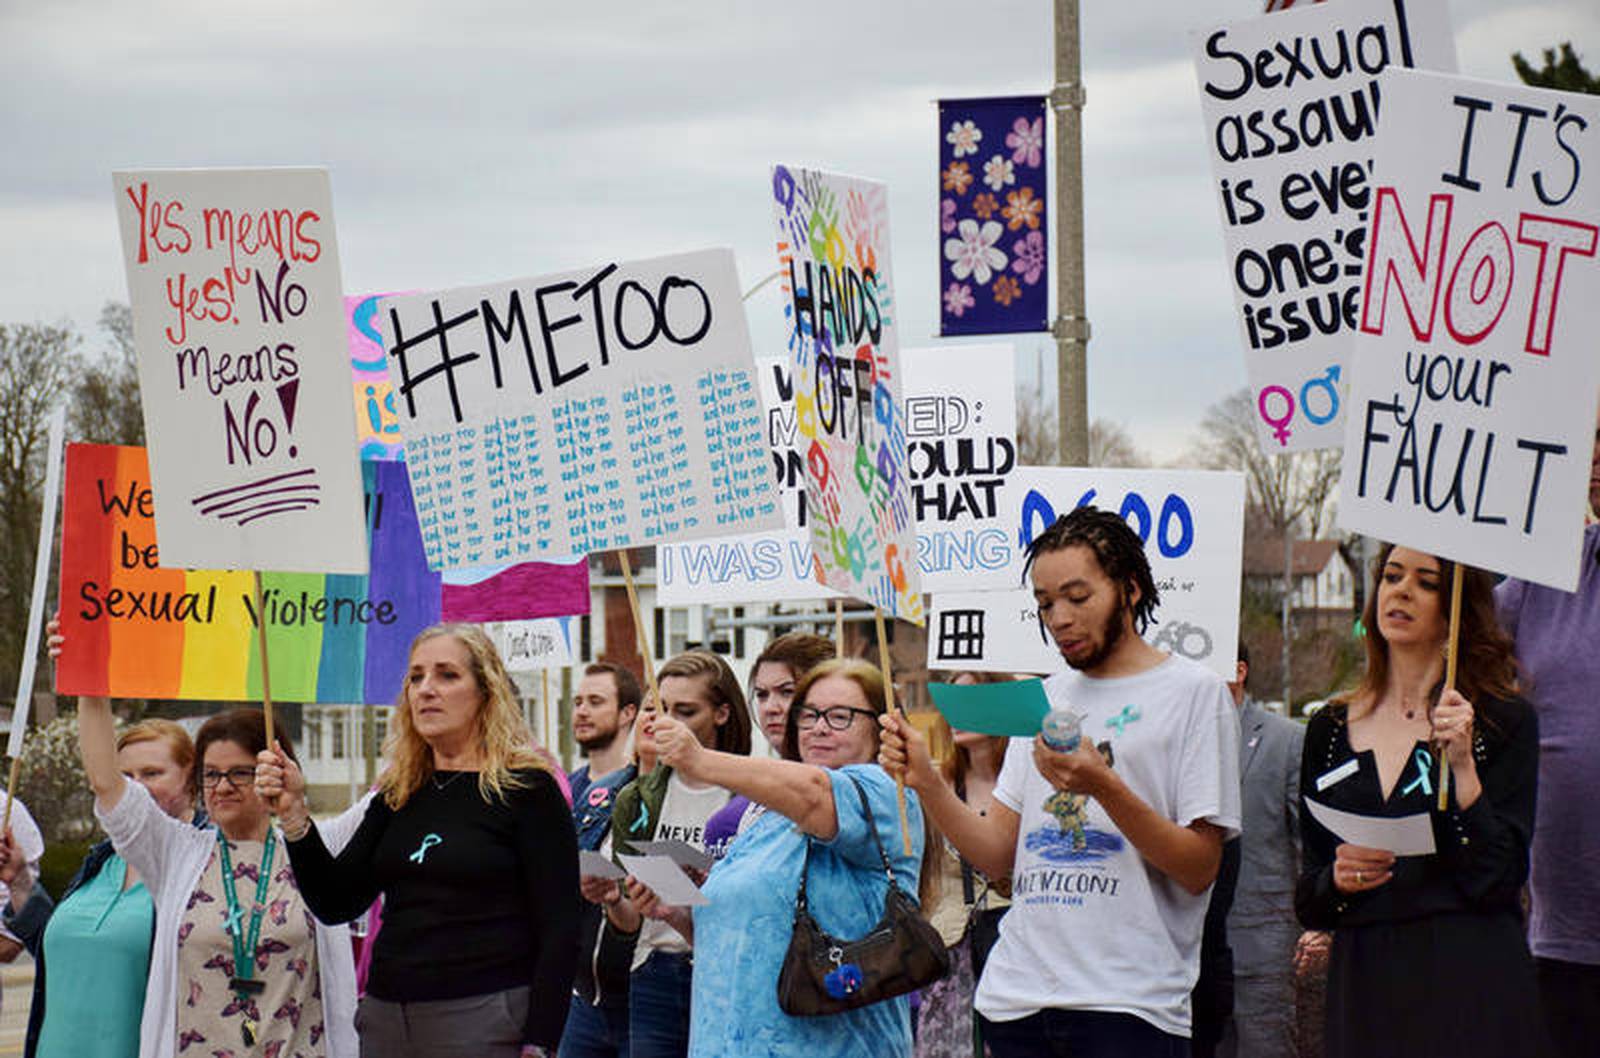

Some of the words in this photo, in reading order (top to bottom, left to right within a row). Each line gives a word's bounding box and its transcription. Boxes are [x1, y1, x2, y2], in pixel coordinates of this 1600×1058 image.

[1204, 0, 1414, 100] Sexual
[1215, 81, 1382, 162] assaul
[1441, 96, 1588, 206] IT'S
[1221, 178, 1265, 226] is
[1281, 159, 1374, 221] eve
[127, 182, 192, 264] Yes
[202, 207, 321, 282] means
[166, 267, 240, 346] yes!
[254, 260, 308, 323] No
[790, 258, 882, 347] HANDS
[1360, 186, 1599, 357] NOT
[390, 262, 713, 423] #METOO
[1243, 286, 1360, 349] issue
[177, 343, 299, 395] means
[815, 352, 874, 447] OFF
[1393, 351, 1512, 426] your
[224, 378, 300, 464] No!
[906, 396, 984, 437] ED:
[908, 436, 1015, 480] OULD
[1358, 399, 1568, 534] FAULT
[98, 479, 154, 518] We
[911, 478, 1005, 523] HAT
[121, 530, 158, 569] be
[680, 541, 782, 584] WAS
[80, 582, 217, 623] Sexual
[242, 588, 398, 627] Violence
[659, 824, 704, 843] NEVE
